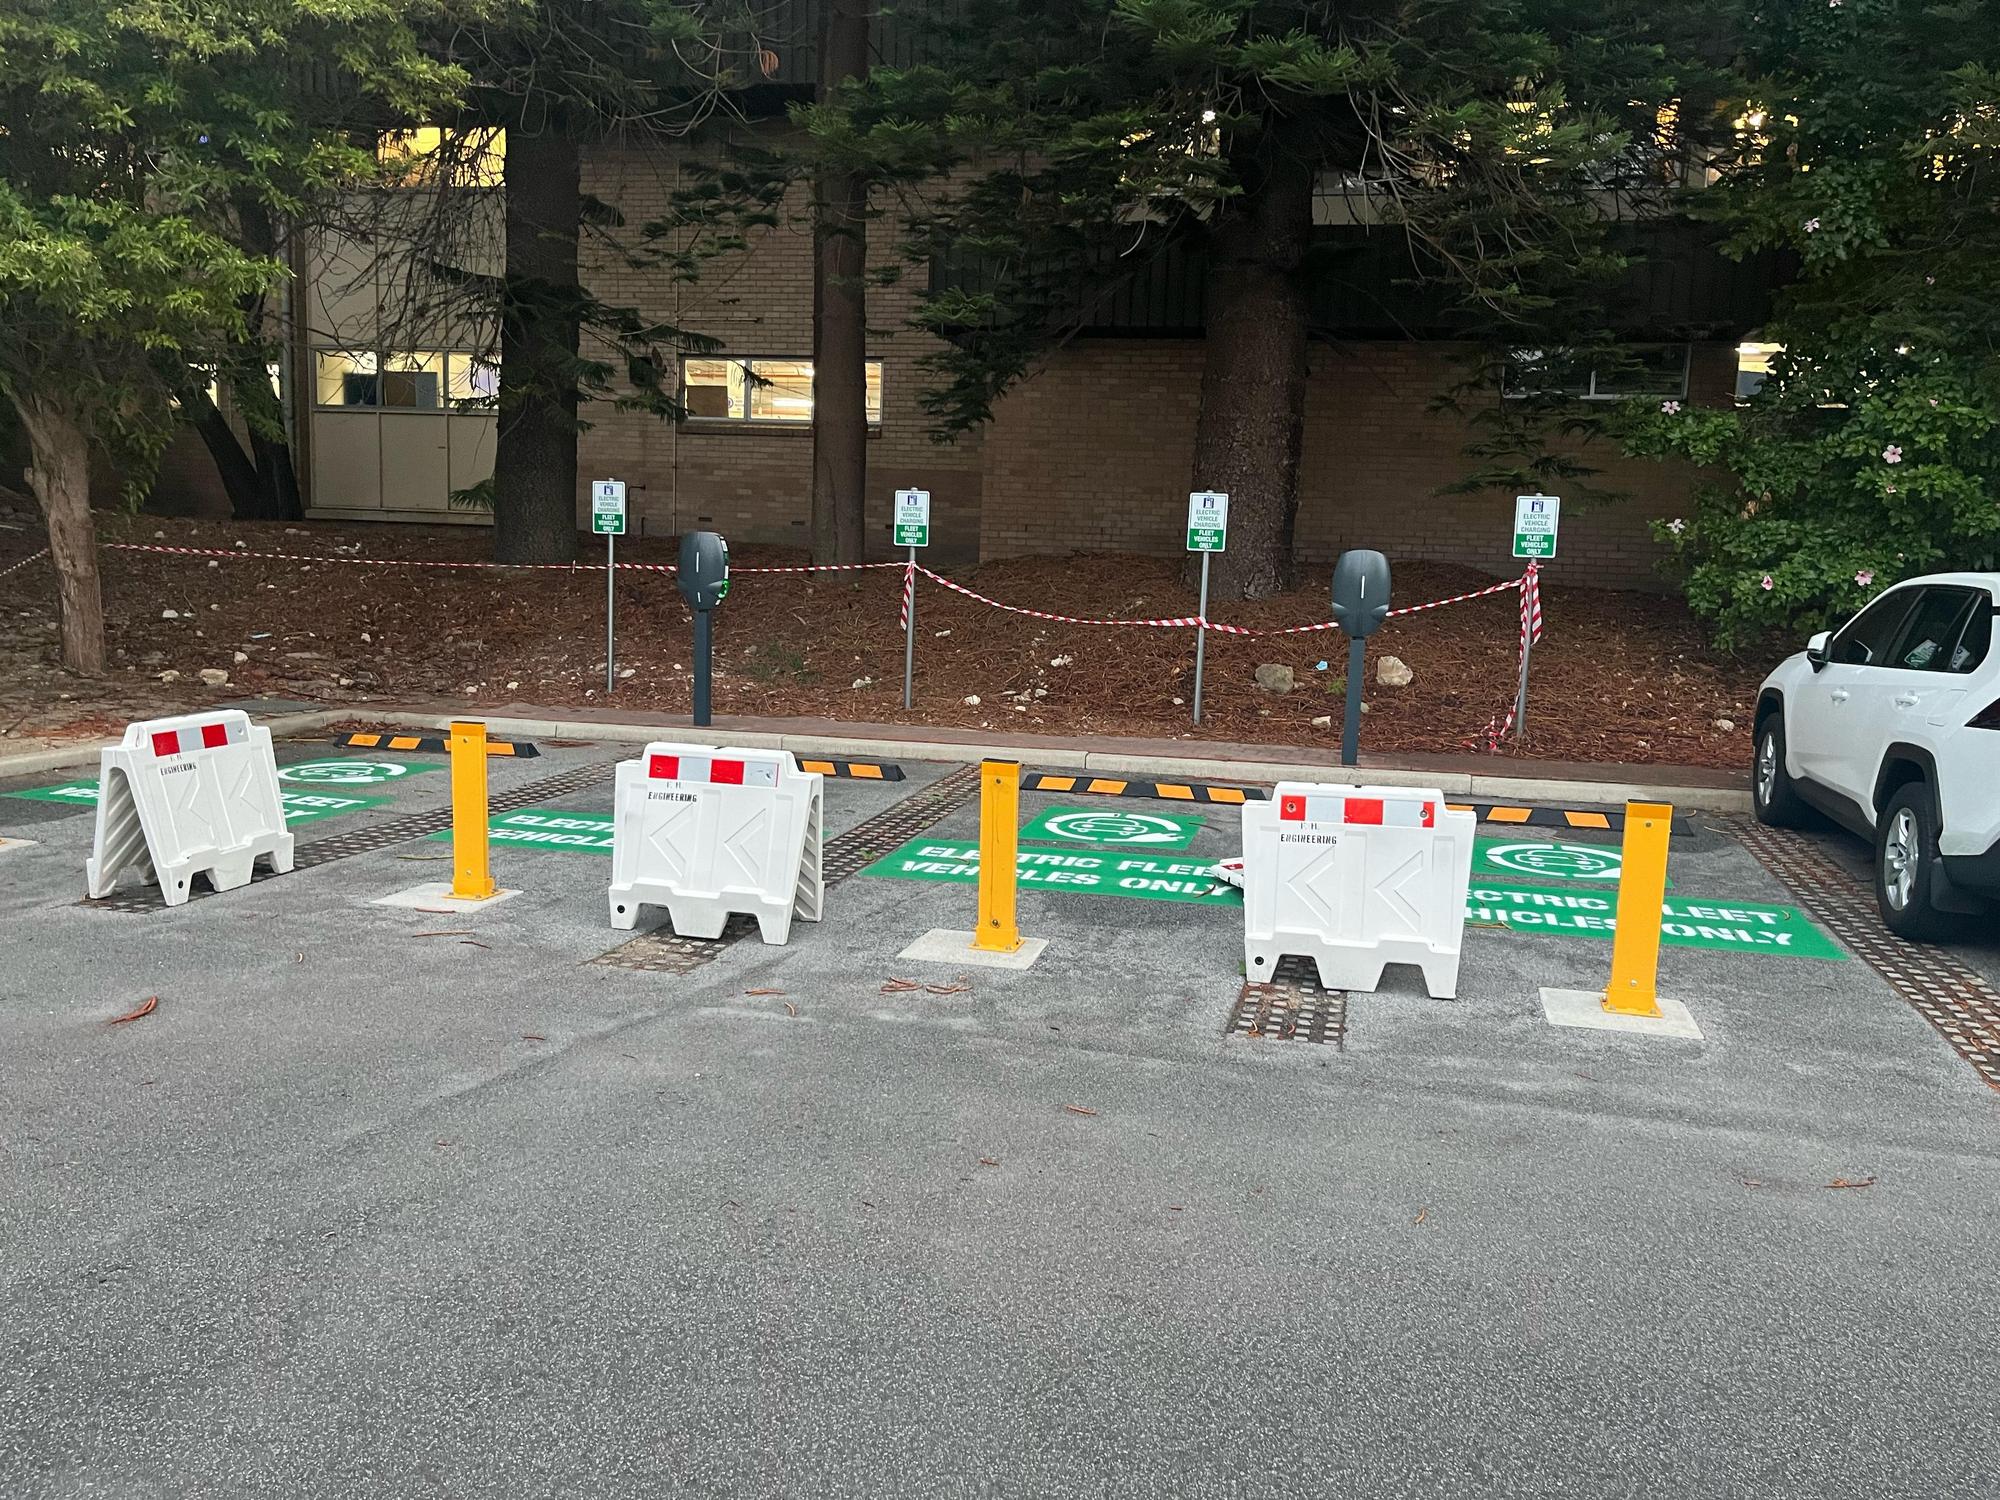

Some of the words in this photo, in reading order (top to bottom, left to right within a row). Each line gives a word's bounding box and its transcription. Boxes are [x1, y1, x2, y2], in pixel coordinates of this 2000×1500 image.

[160, 762, 197, 776] ENGINEERING
[647, 791, 697, 803] ENGINEERING
[1280, 833, 1337, 845] ENGINEERING
[917, 846, 1103, 868] ELETRIC
[1117, 860, 1216, 878] FLEE
[902, 860, 1101, 885] VEHLES
[1118, 877, 1233, 896] ONLY
[1661, 904, 1778, 925] LEET
[1661, 923, 1793, 946] ONLY
